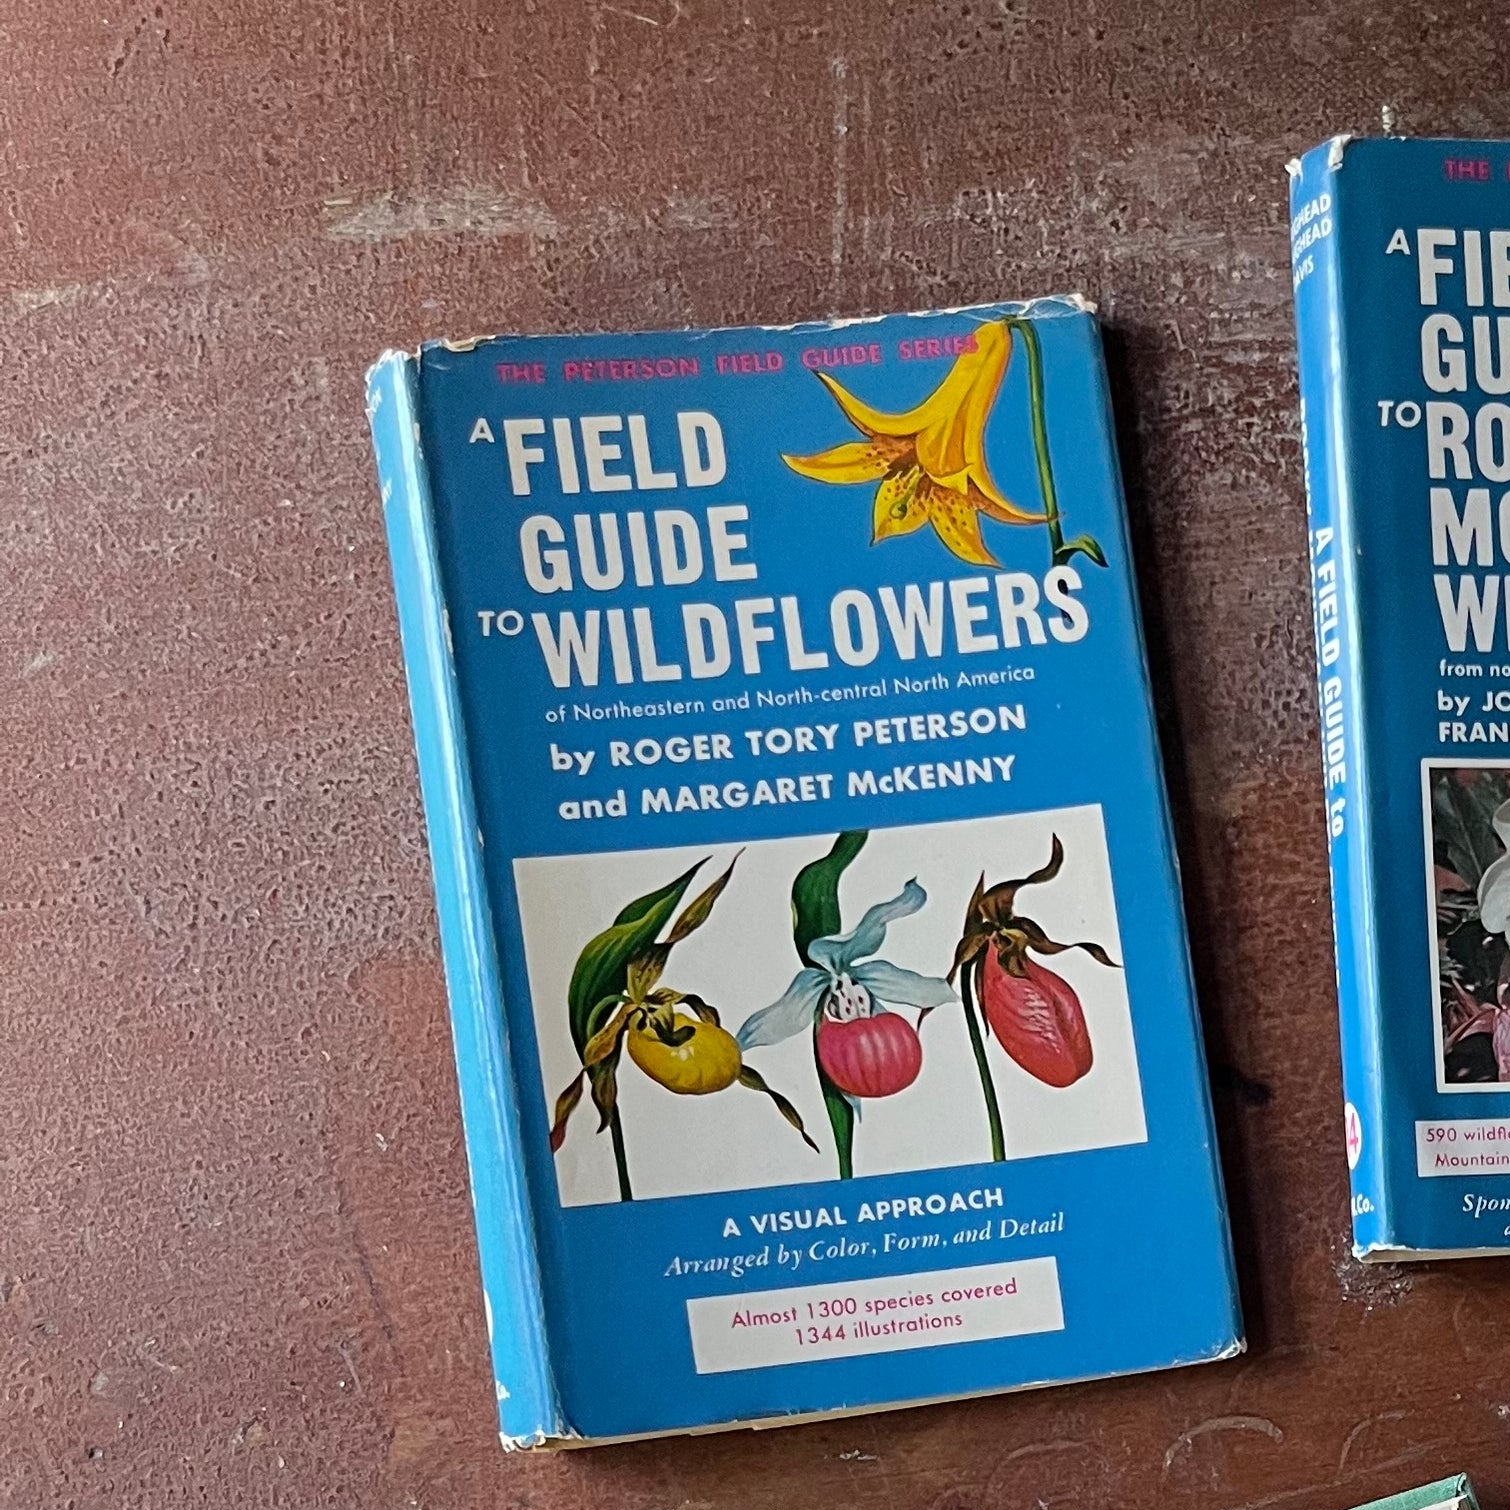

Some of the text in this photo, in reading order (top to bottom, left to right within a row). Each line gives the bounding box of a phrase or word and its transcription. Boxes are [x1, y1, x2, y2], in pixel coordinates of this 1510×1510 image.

[1385, 229, 1410, 255] A
[496, 362, 545, 384] THE
[563, 357, 700, 382] PETERSON
[715, 351, 785, 374] FIELD
[801, 344, 881, 369] GUIDE
[1377, 400, 1420, 428] TO
[470, 411, 728, 496] A FIELD
[519, 505, 758, 594] GUIDE
[1314, 527, 1334, 556] A
[477, 565, 1089, 689] TO WILDFLOWERS
[1317, 562, 1340, 666] FIELD
[545, 667, 1036, 723] of Northeastern and North-central North America
[1437, 689, 1471, 717] by
[549, 703, 1027, 776] by ROGER TORY PETERSON
[1323, 676, 1347, 785] GUIDE
[558, 754, 1015, 821] and MARGARET McKENNY
[1330, 797, 1346, 838] to
[1425, 1127, 1457, 1143] 590
[722, 1187, 1004, 1238] A VISUAL APPROACH
[663, 1211, 1064, 1278] Arranged by Color, Form, and Detail
[731, 1276, 1018, 1329] Almost 1300 species covered
[795, 1314, 963, 1346] 1344 illustrations
